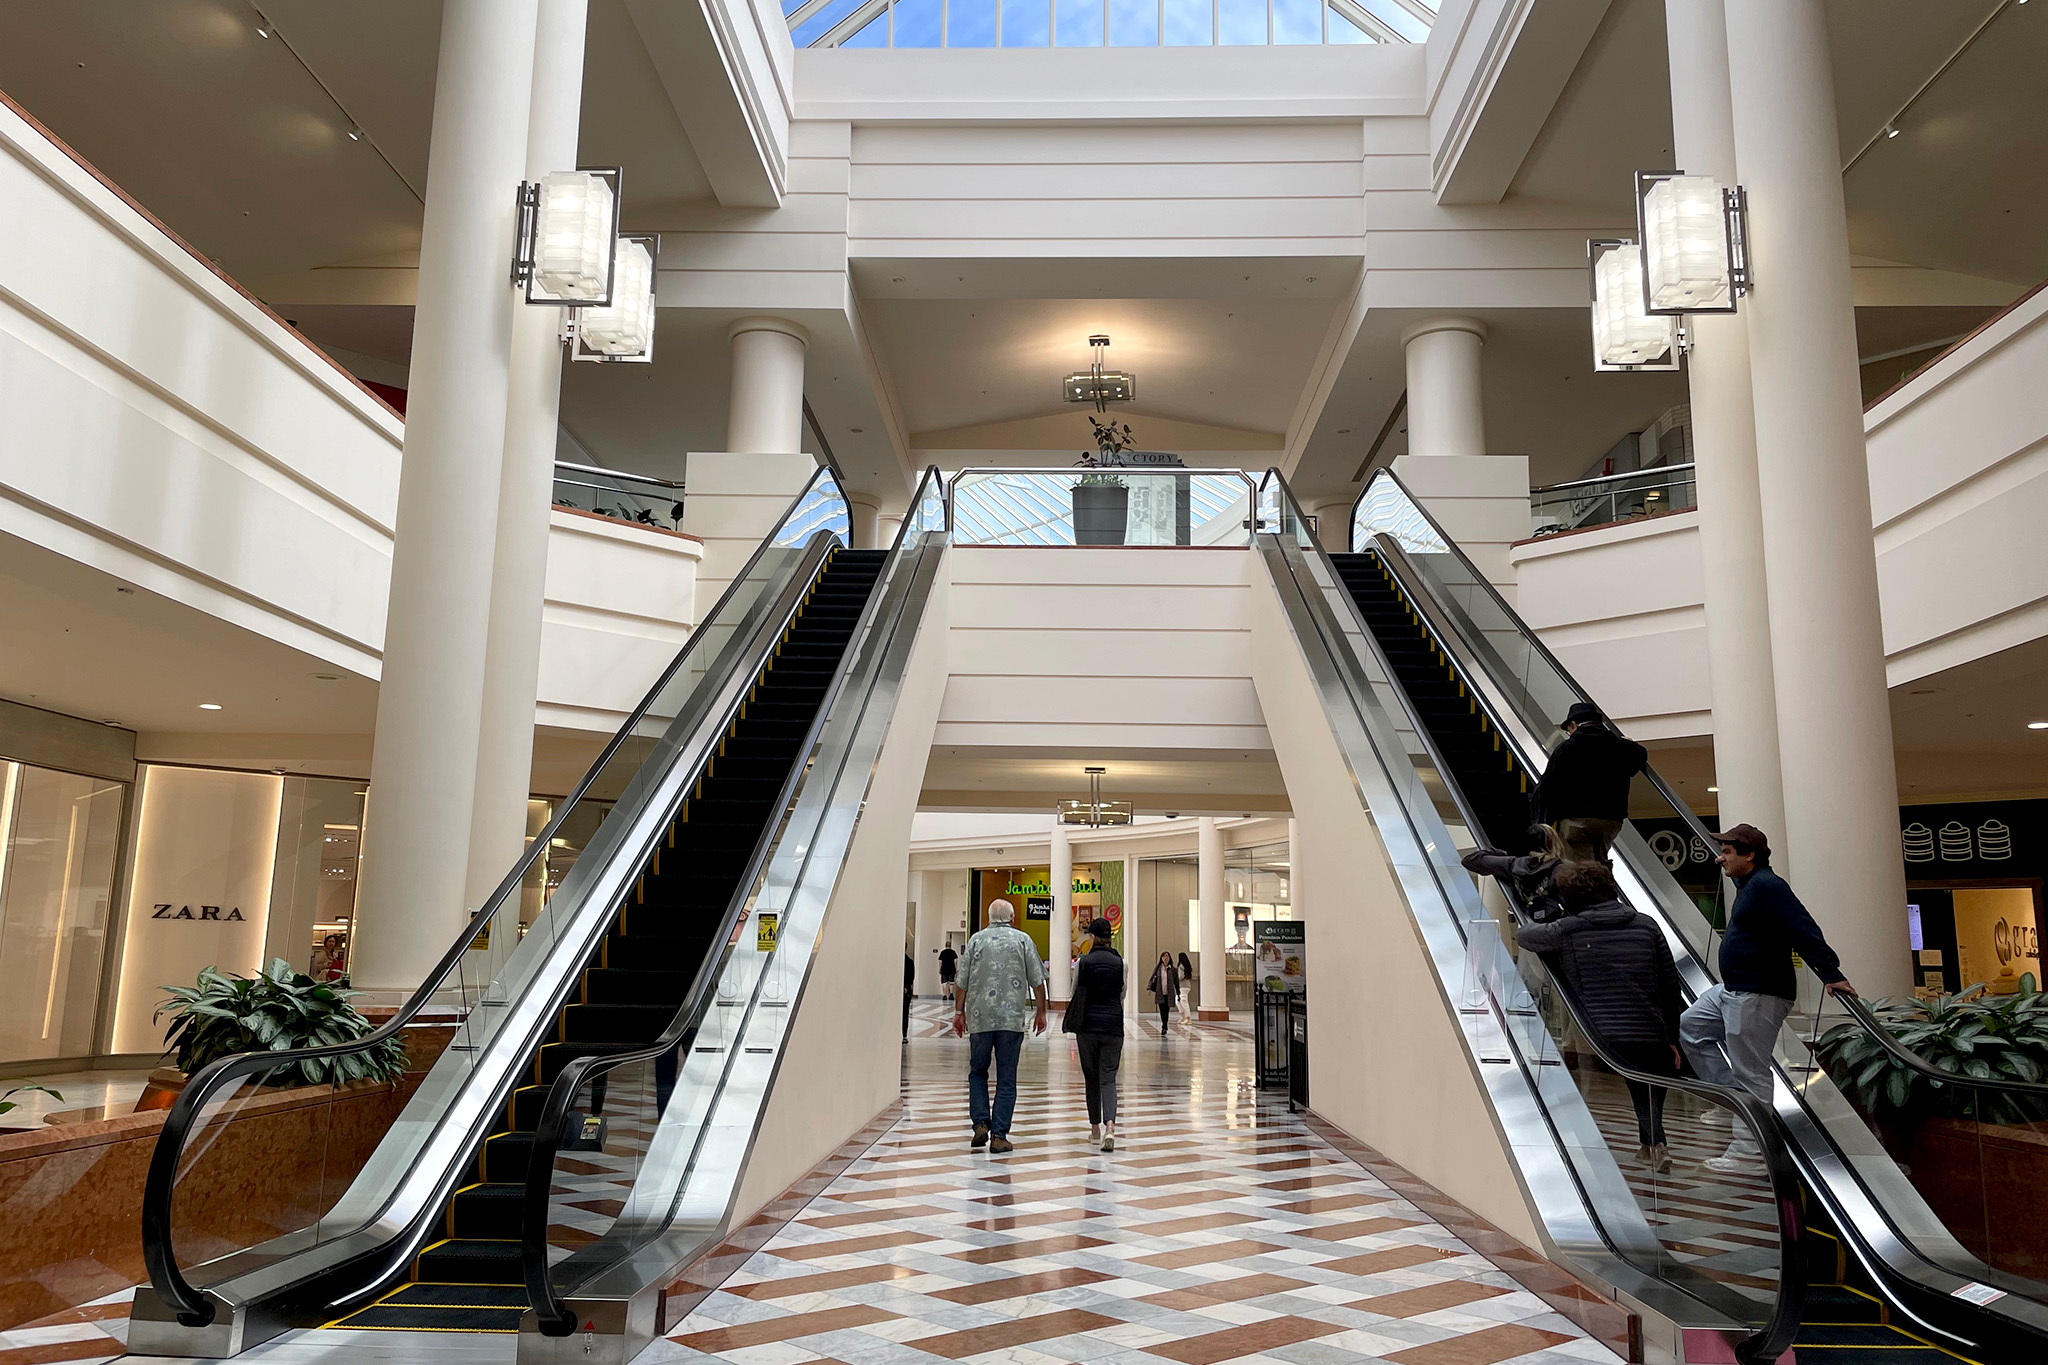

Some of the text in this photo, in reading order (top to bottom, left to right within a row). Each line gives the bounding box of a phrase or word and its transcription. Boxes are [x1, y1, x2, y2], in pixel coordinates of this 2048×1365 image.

[1127, 454, 1174, 463] CTORY
[1072, 879, 1101, 893] Juic
[152, 904, 246, 921] ZARA
[2013, 926, 2038, 957] gra
[584, 1333, 593, 1341] 13
